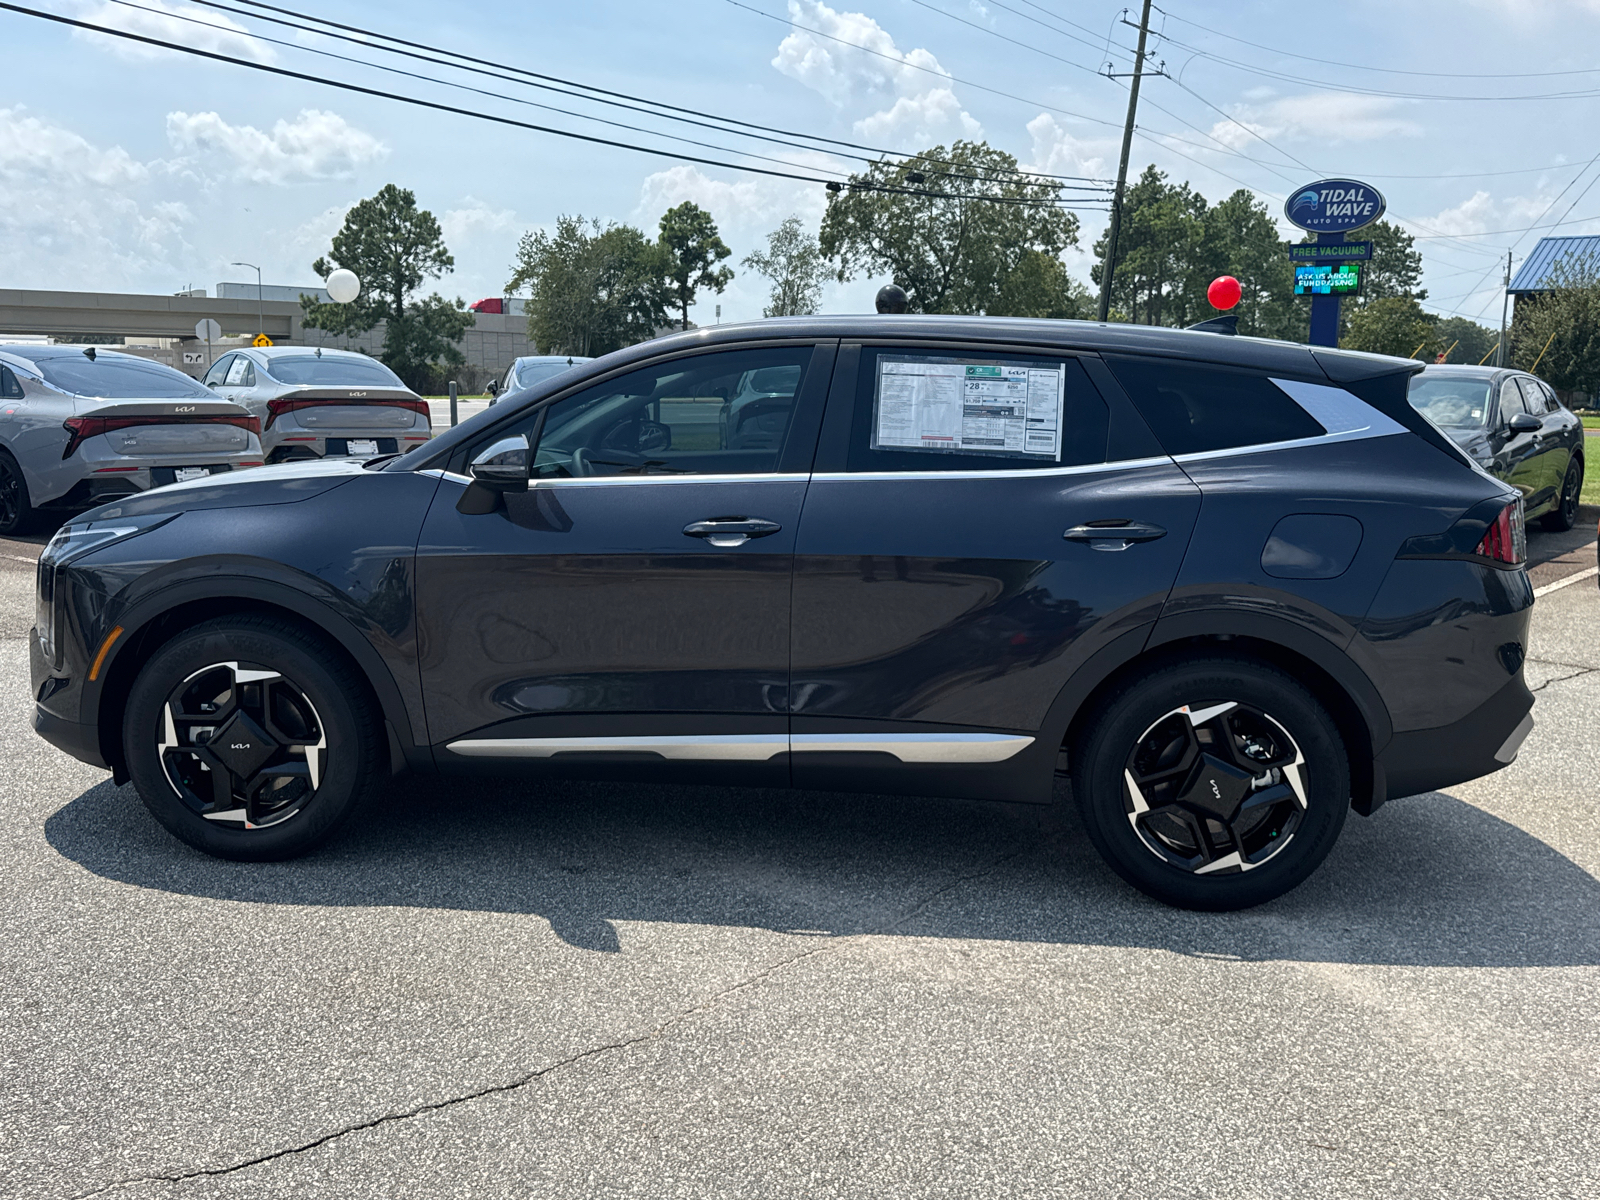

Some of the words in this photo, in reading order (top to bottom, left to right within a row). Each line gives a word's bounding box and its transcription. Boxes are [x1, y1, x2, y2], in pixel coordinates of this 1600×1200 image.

[1319, 188, 1365, 203] TIDAL
[1325, 202, 1374, 216] WAVE
[1292, 247, 1317, 257] FREE
[1320, 245, 1366, 257] VACUUMS
[969, 382, 980, 390] 28
[231, 742, 250, 750] KIA
[1210, 779, 1221, 799] KIA
